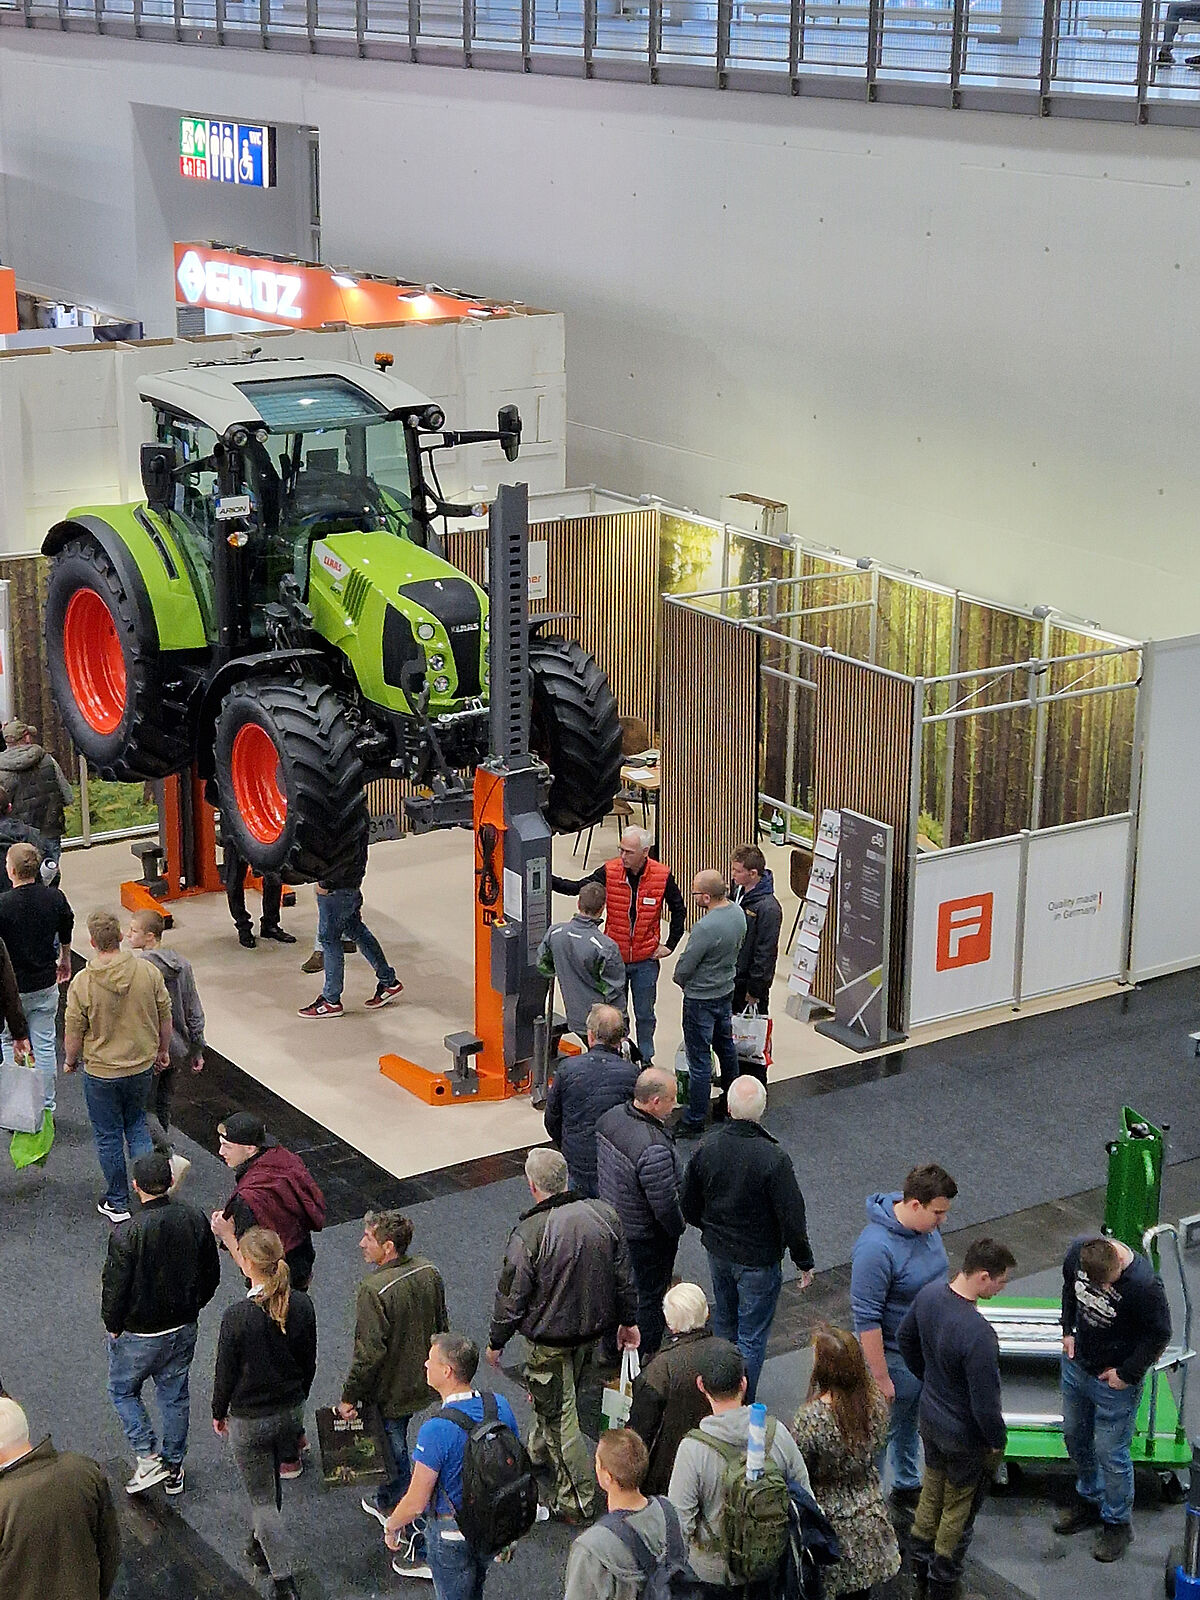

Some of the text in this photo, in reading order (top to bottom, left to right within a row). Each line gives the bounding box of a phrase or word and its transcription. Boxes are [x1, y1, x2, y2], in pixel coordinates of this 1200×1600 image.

[248, 130, 262, 145] WC
[204, 260, 303, 319] GROZ
[219, 506, 247, 515] ARION
[323, 555, 342, 572] CLAAS
[1047, 893, 1098, 911] Quality made
[1063, 906, 1097, 919] Germany
